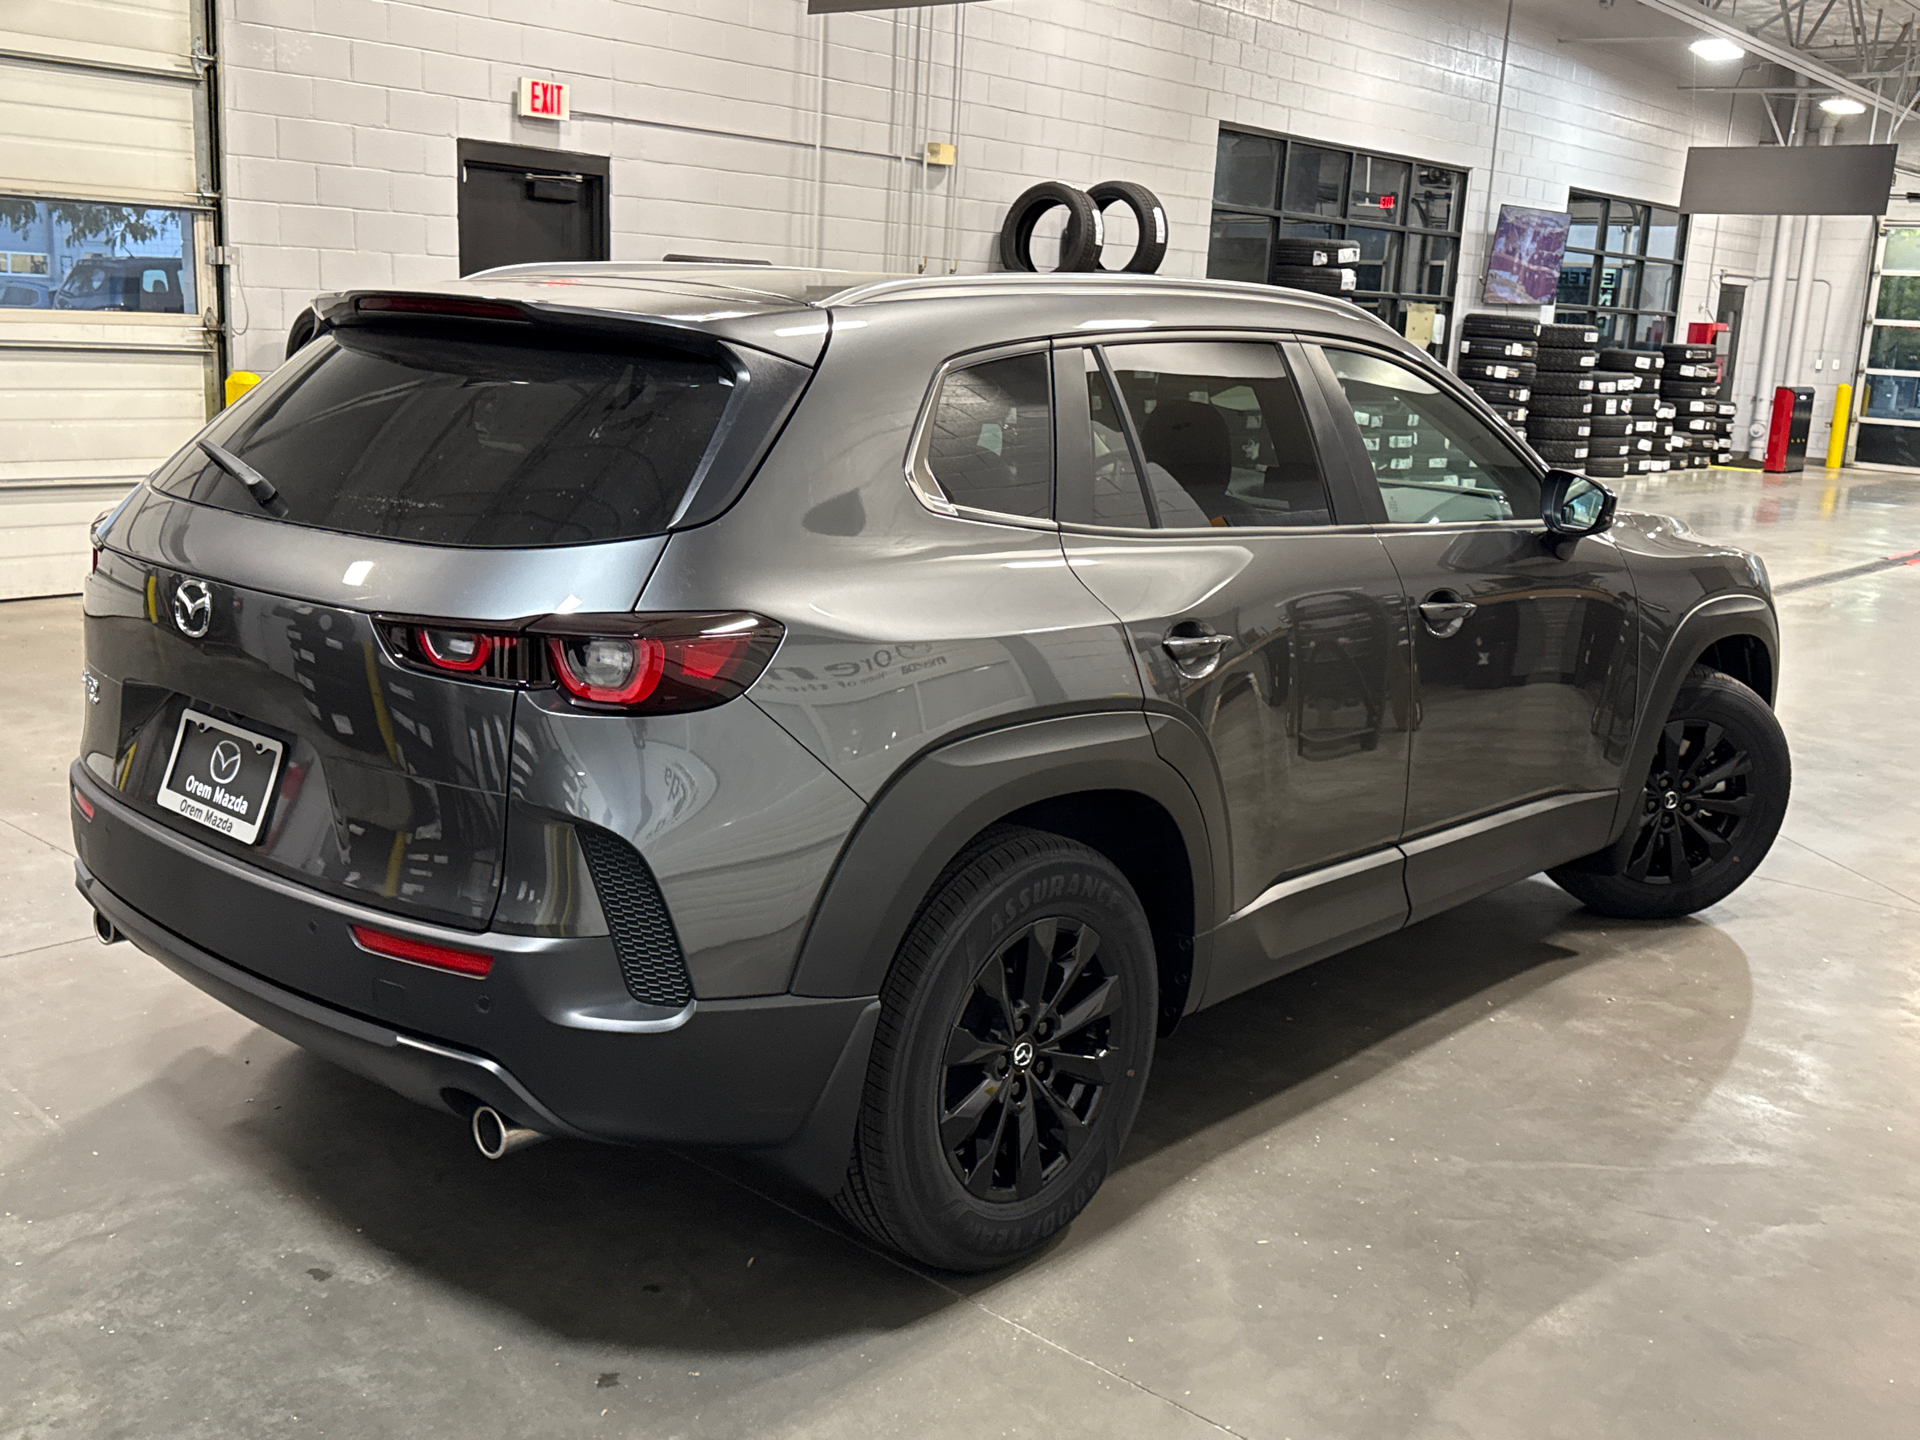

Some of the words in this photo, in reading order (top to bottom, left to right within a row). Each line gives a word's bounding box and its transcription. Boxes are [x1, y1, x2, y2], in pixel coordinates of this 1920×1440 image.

[530, 80, 563, 116] EXIT
[185, 774, 212, 800] Orem
[212, 785, 249, 815] Mazda
[179, 799, 204, 820] Orem
[203, 811, 234, 834] Mazda
